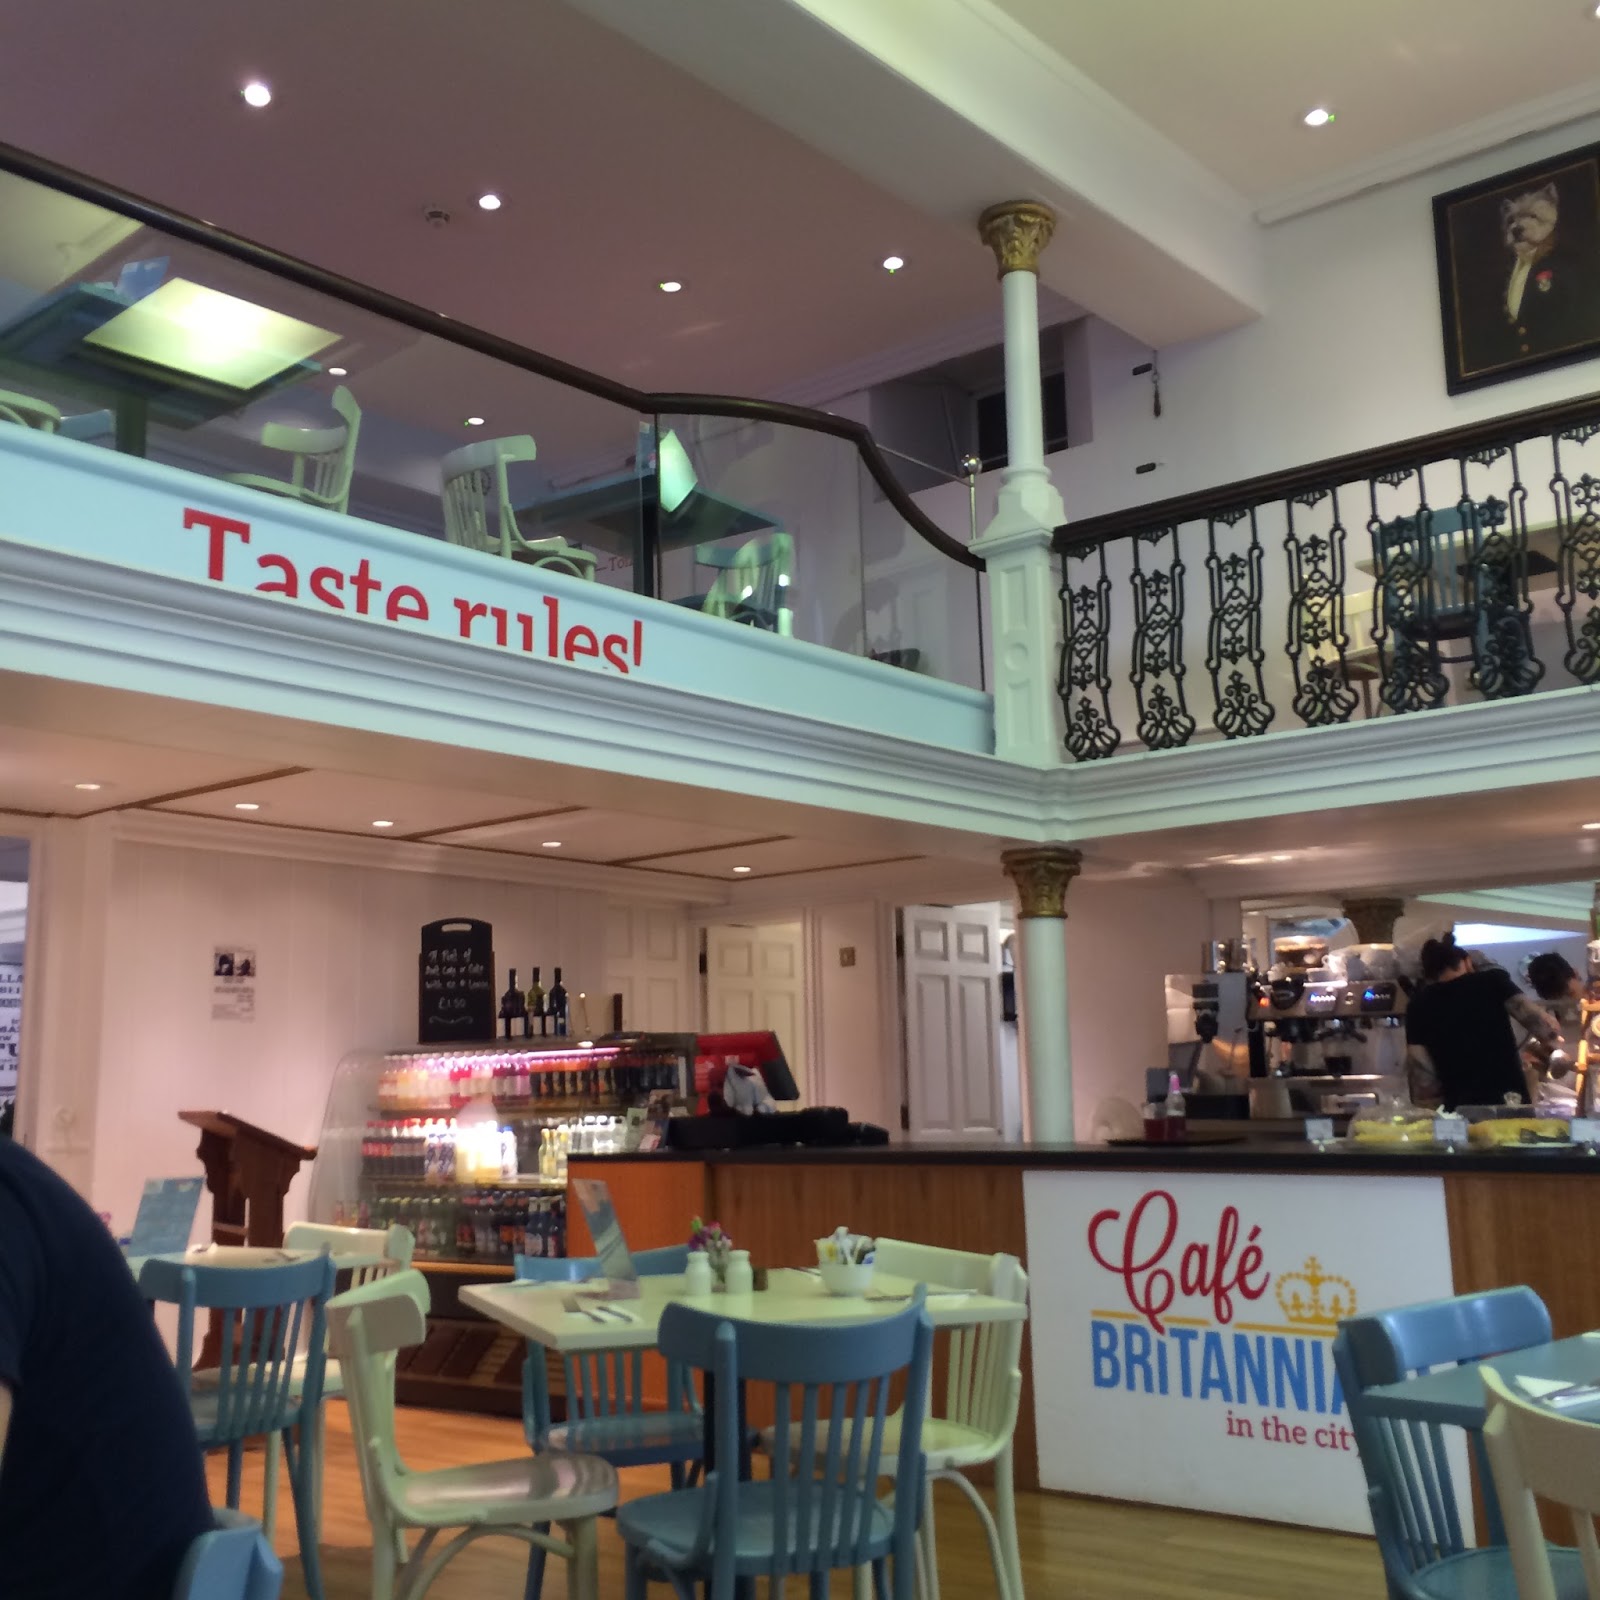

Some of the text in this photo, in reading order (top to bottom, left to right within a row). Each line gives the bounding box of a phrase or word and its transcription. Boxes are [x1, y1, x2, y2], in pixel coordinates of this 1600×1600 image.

[183, 508, 643, 674] Taste rules!
[1087, 1189, 1270, 1334] Café
[1226, 1409, 1254, 1439] in
[1261, 1415, 1307, 1445] the
